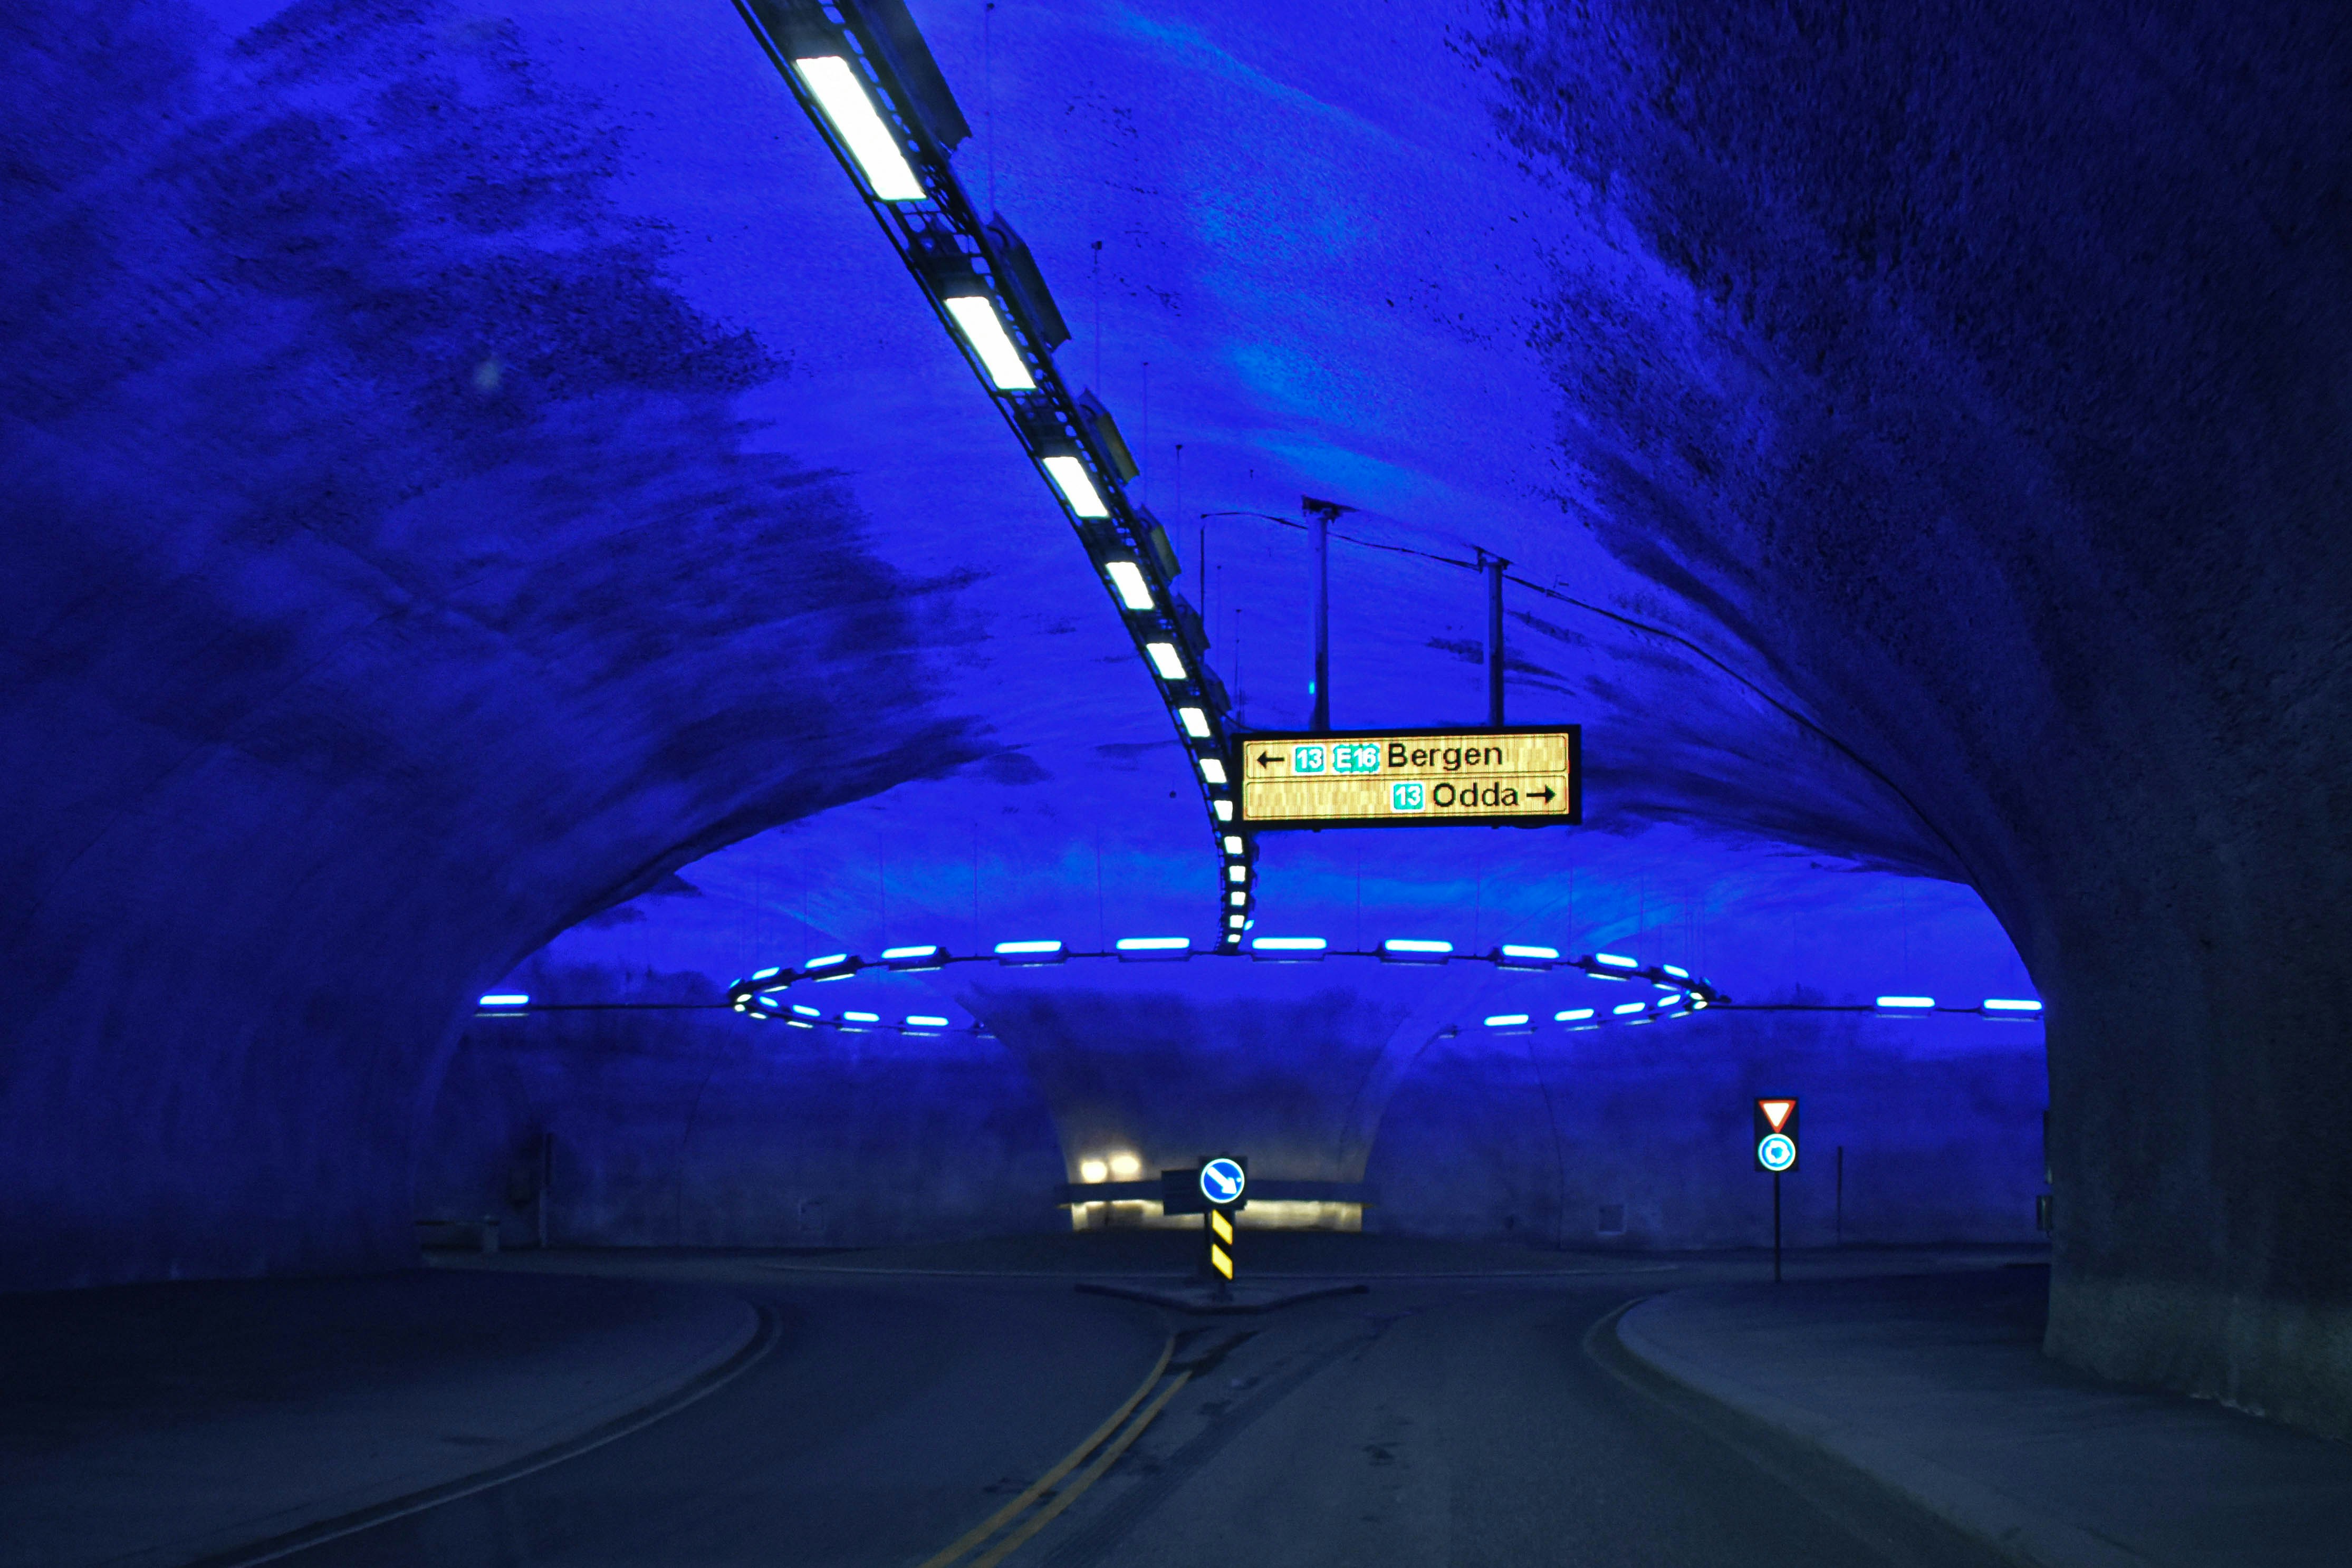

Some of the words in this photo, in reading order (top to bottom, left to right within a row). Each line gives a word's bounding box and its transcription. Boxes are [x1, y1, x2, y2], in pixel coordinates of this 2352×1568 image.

[1297, 748, 1322, 768] 13
[1336, 747, 1377, 768] E16
[1388, 744, 1503, 771] Bergen
[1396, 786, 1422, 806] 13
[1433, 782, 1519, 807] Odda
